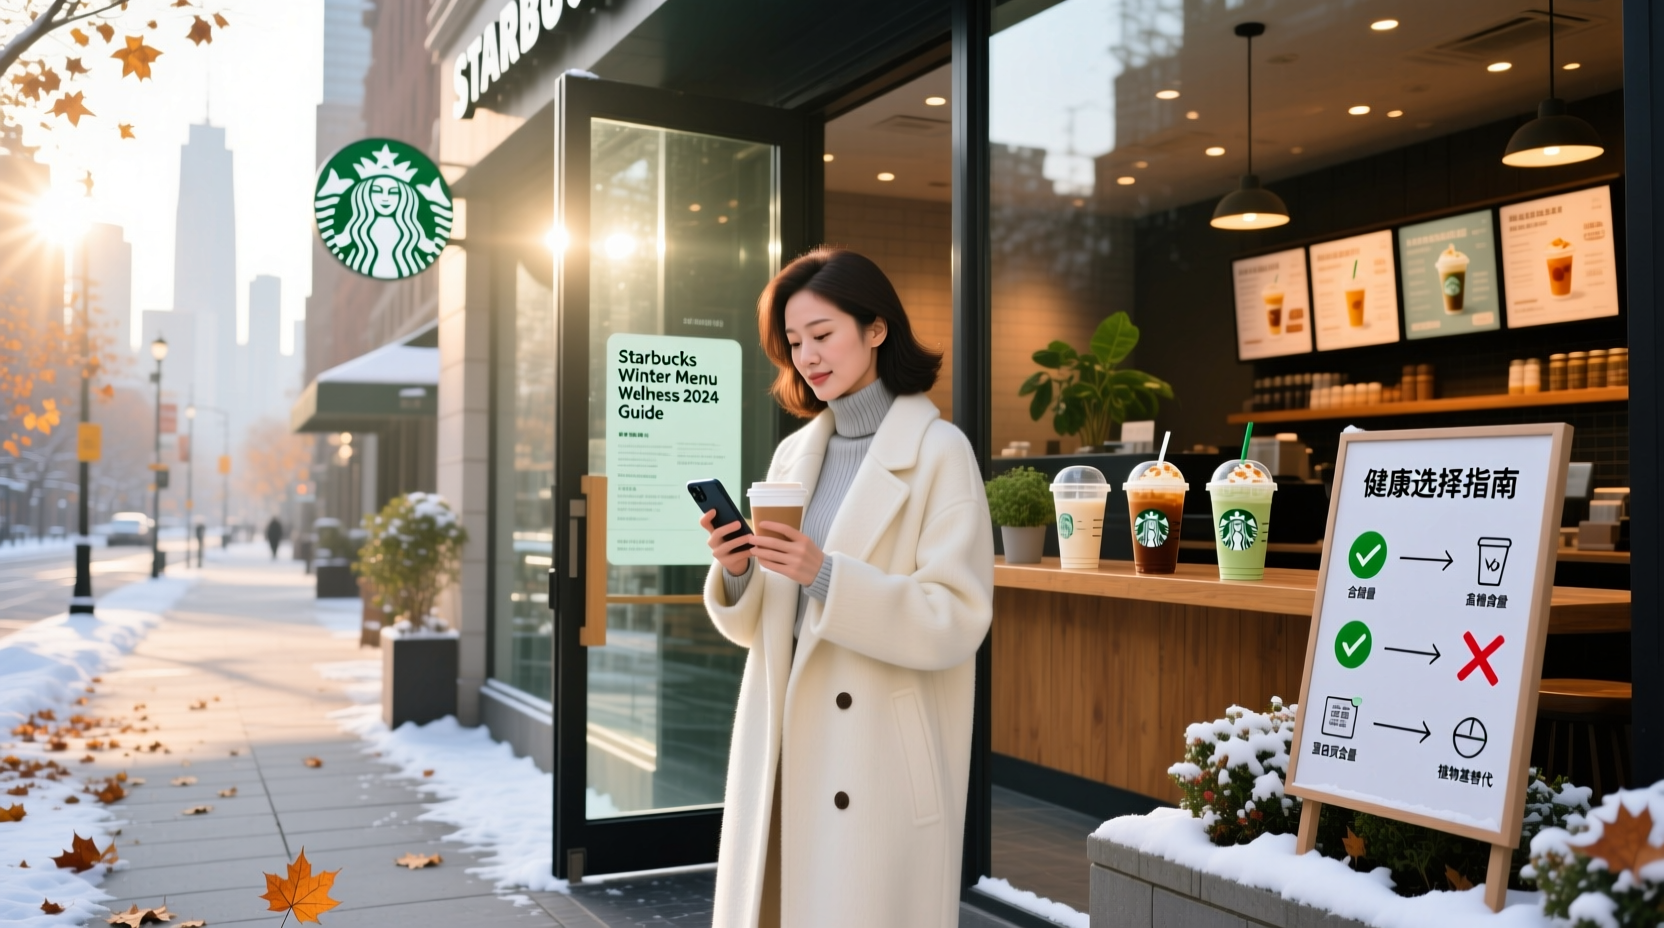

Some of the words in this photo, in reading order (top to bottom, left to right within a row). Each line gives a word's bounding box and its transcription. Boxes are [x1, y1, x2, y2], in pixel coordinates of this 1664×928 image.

[618, 349, 697, 367] Starbucks
[618, 367, 671, 384] Winter
[675, 369, 718, 386] Menu
[682, 388, 720, 404] 2024
[618, 403, 664, 420] Guide
[1363, 466, 1520, 500] 健康选择指南
